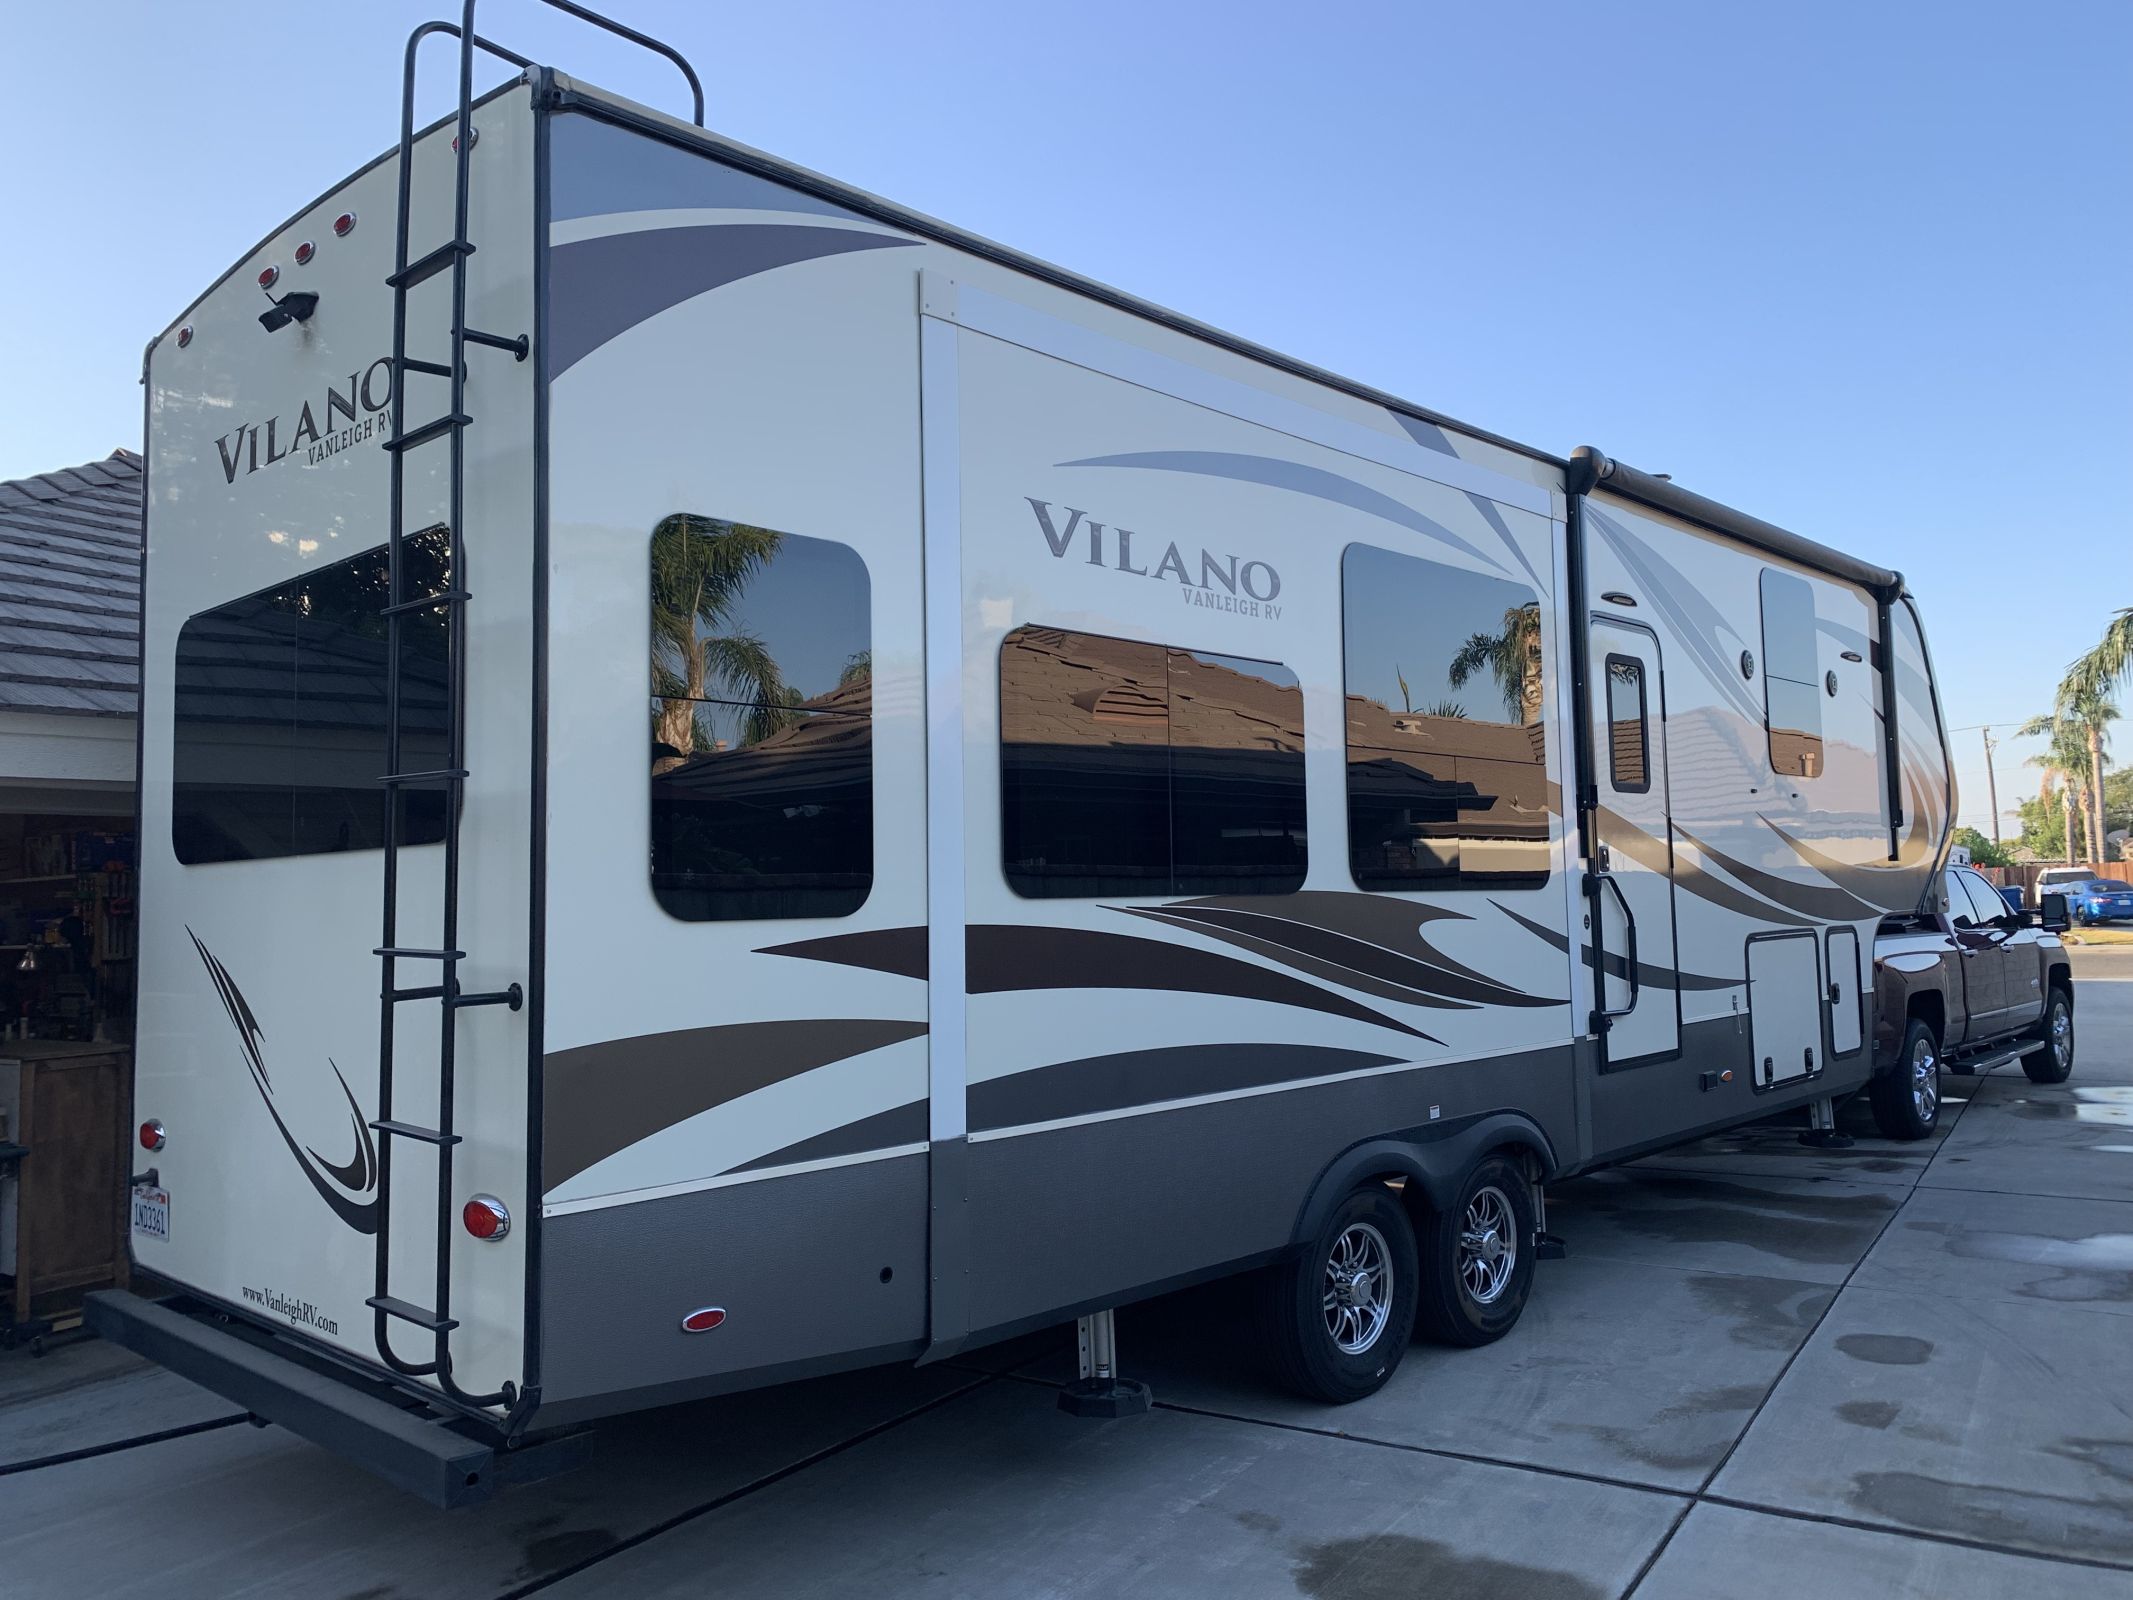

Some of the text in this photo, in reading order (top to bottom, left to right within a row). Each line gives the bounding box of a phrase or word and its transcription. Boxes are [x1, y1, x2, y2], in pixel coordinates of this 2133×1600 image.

[214, 357, 393, 485] VILANO
[308, 417, 373, 466] VANLEIGH
[1023, 496, 1281, 602] VILANO
[1182, 587, 1283, 621] VANLEIGH RV
[242, 1286, 338, 1335] www.VanleighRV.com
